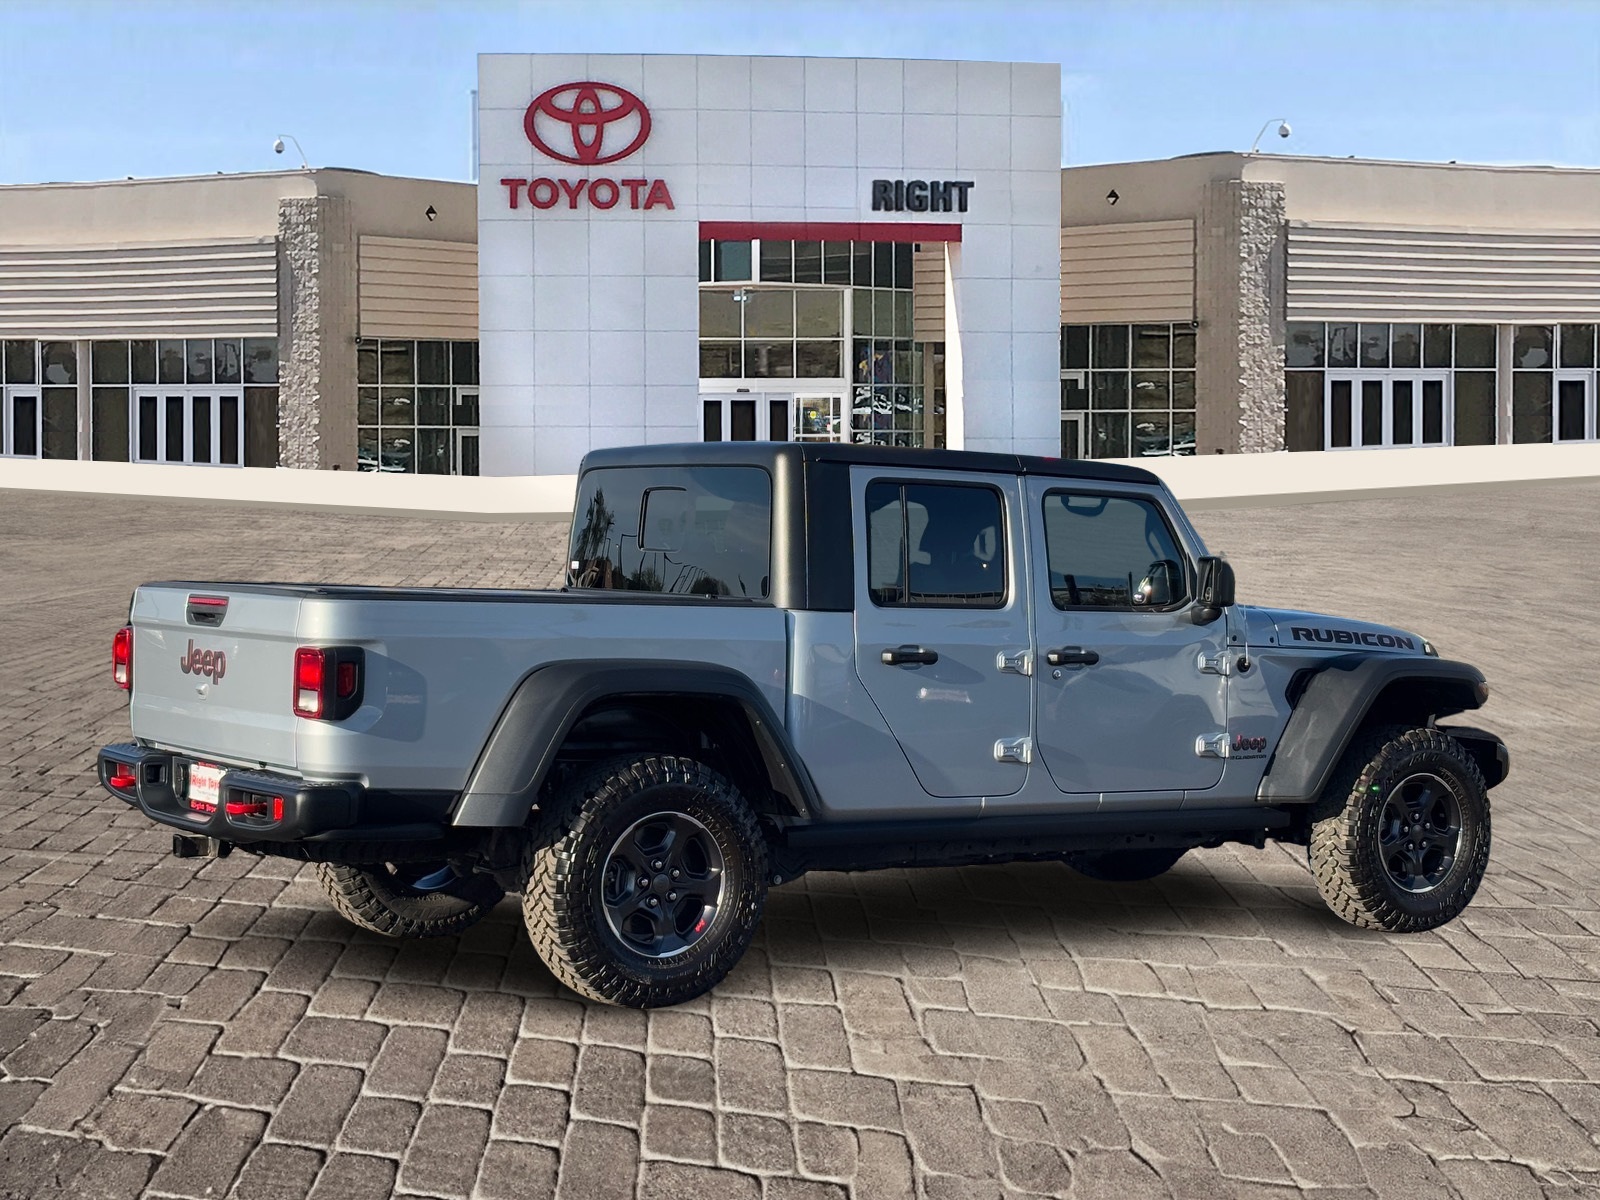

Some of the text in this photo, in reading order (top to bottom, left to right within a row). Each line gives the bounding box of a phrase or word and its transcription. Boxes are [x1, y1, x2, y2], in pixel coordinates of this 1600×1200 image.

[500, 177, 676, 210] TOYOTA
[871, 179, 975, 213] RIGHT
[1290, 626, 1415, 650] RUBICON
[180, 638, 226, 685] Jeep
[1232, 734, 1267, 753] Jeep
[191, 774, 207, 788] Right
